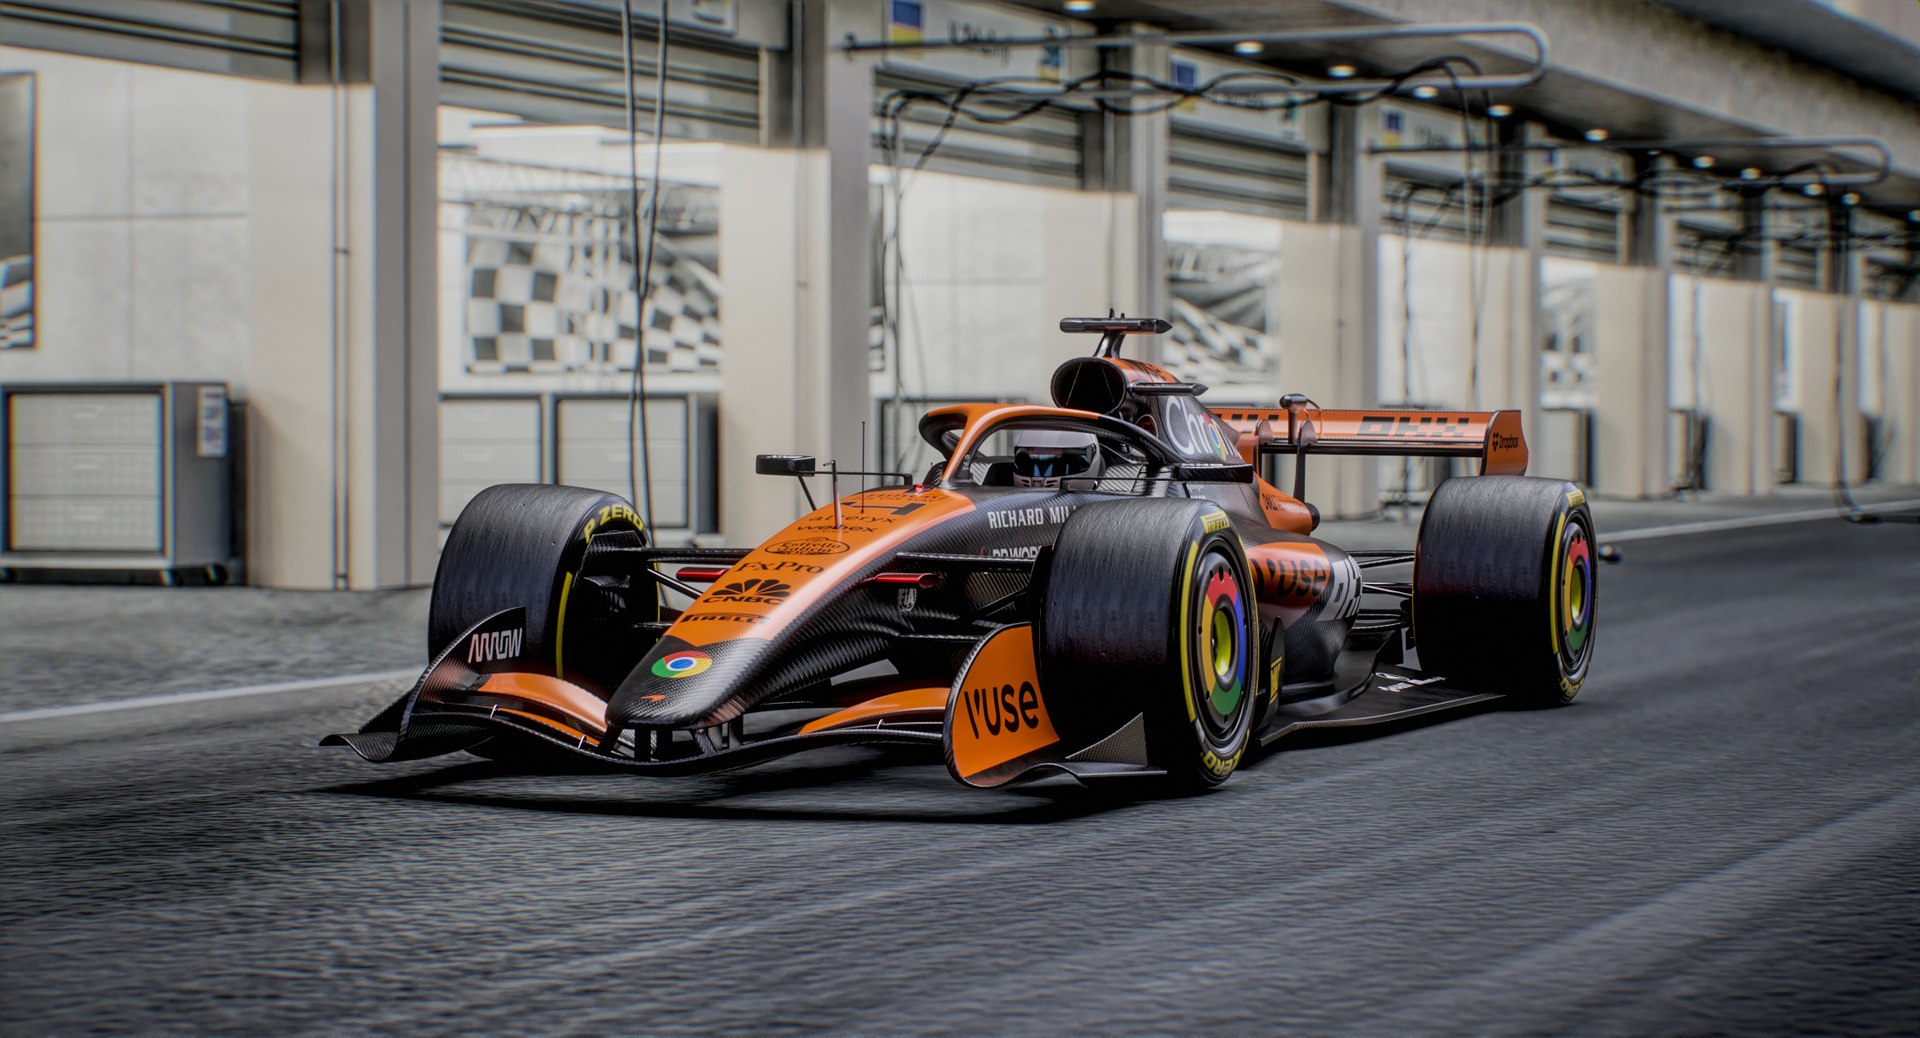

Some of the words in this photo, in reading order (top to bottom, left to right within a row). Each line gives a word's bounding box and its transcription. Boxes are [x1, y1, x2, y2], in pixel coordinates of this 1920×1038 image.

[584, 518, 595, 544] P
[599, 504, 644, 531] ZERO
[808, 515, 897, 523] aleryx
[987, 508, 1044, 529] RICHARD
[735, 561, 825, 574] FxPro
[702, 596, 785, 605] CNBC
[468, 627, 523, 664] ARROW
